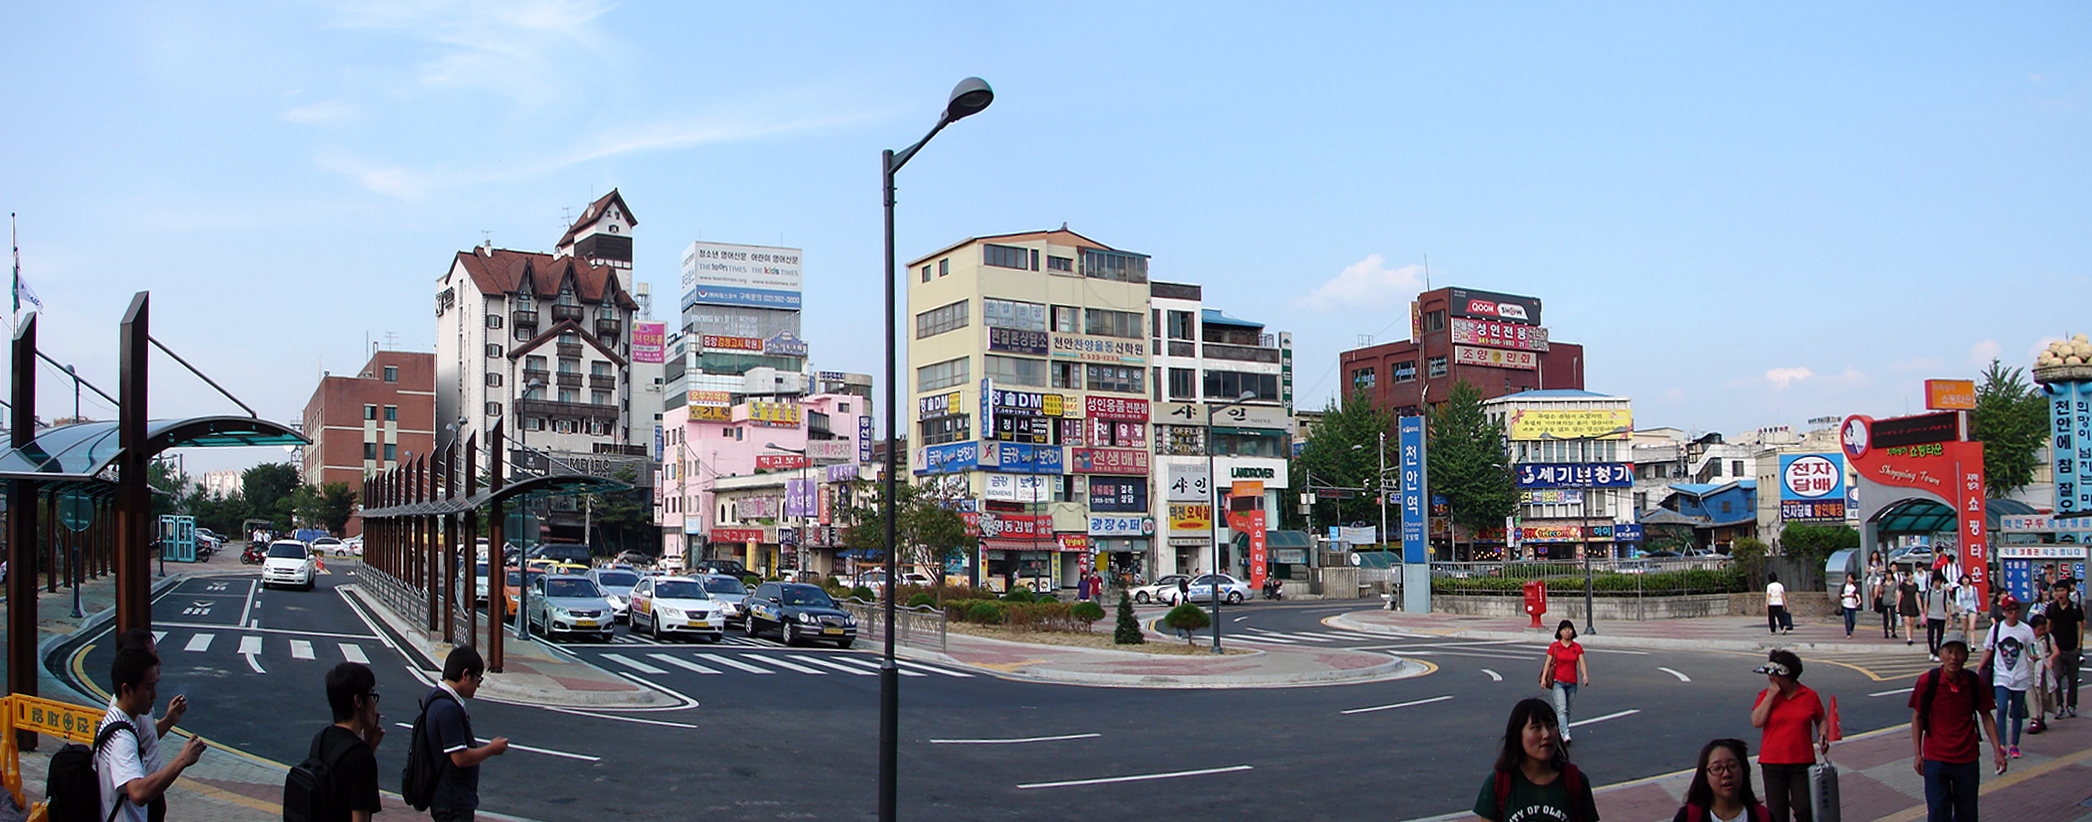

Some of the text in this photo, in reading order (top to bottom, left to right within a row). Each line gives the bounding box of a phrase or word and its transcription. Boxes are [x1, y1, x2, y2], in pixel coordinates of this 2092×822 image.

[699, 249, 799, 265] 청소년 영어신문 어린이 영어신문
[729, 265, 747, 273] TIMES
[752, 266, 763, 274] THE
[1477, 322, 1526, 340] 성인전용
[1088, 397, 1125, 413] 성인용품
[2055, 400, 2071, 450] 천안에
[957, 446, 977, 463] 보청기
[1039, 449, 1062, 465] 보청기
[1909, 443, 1944, 457] 쇼핑타운
[1093, 450, 1147, 467] 천생배필
[2058, 459, 2073, 474] 참
[1537, 465, 1630, 484] 세기보청기
[1792, 462, 1831, 476] 전자
[1879, 464, 1940, 485] Shopping Town
[1171, 476, 1207, 494] 샤인
[1405, 444, 1419, 516] 천안역
[1091, 518, 1140, 531] 광장슈퍼
[1968, 496, 1984, 584] 쇼핑타운
[1526, 805, 1540, 815] OF
